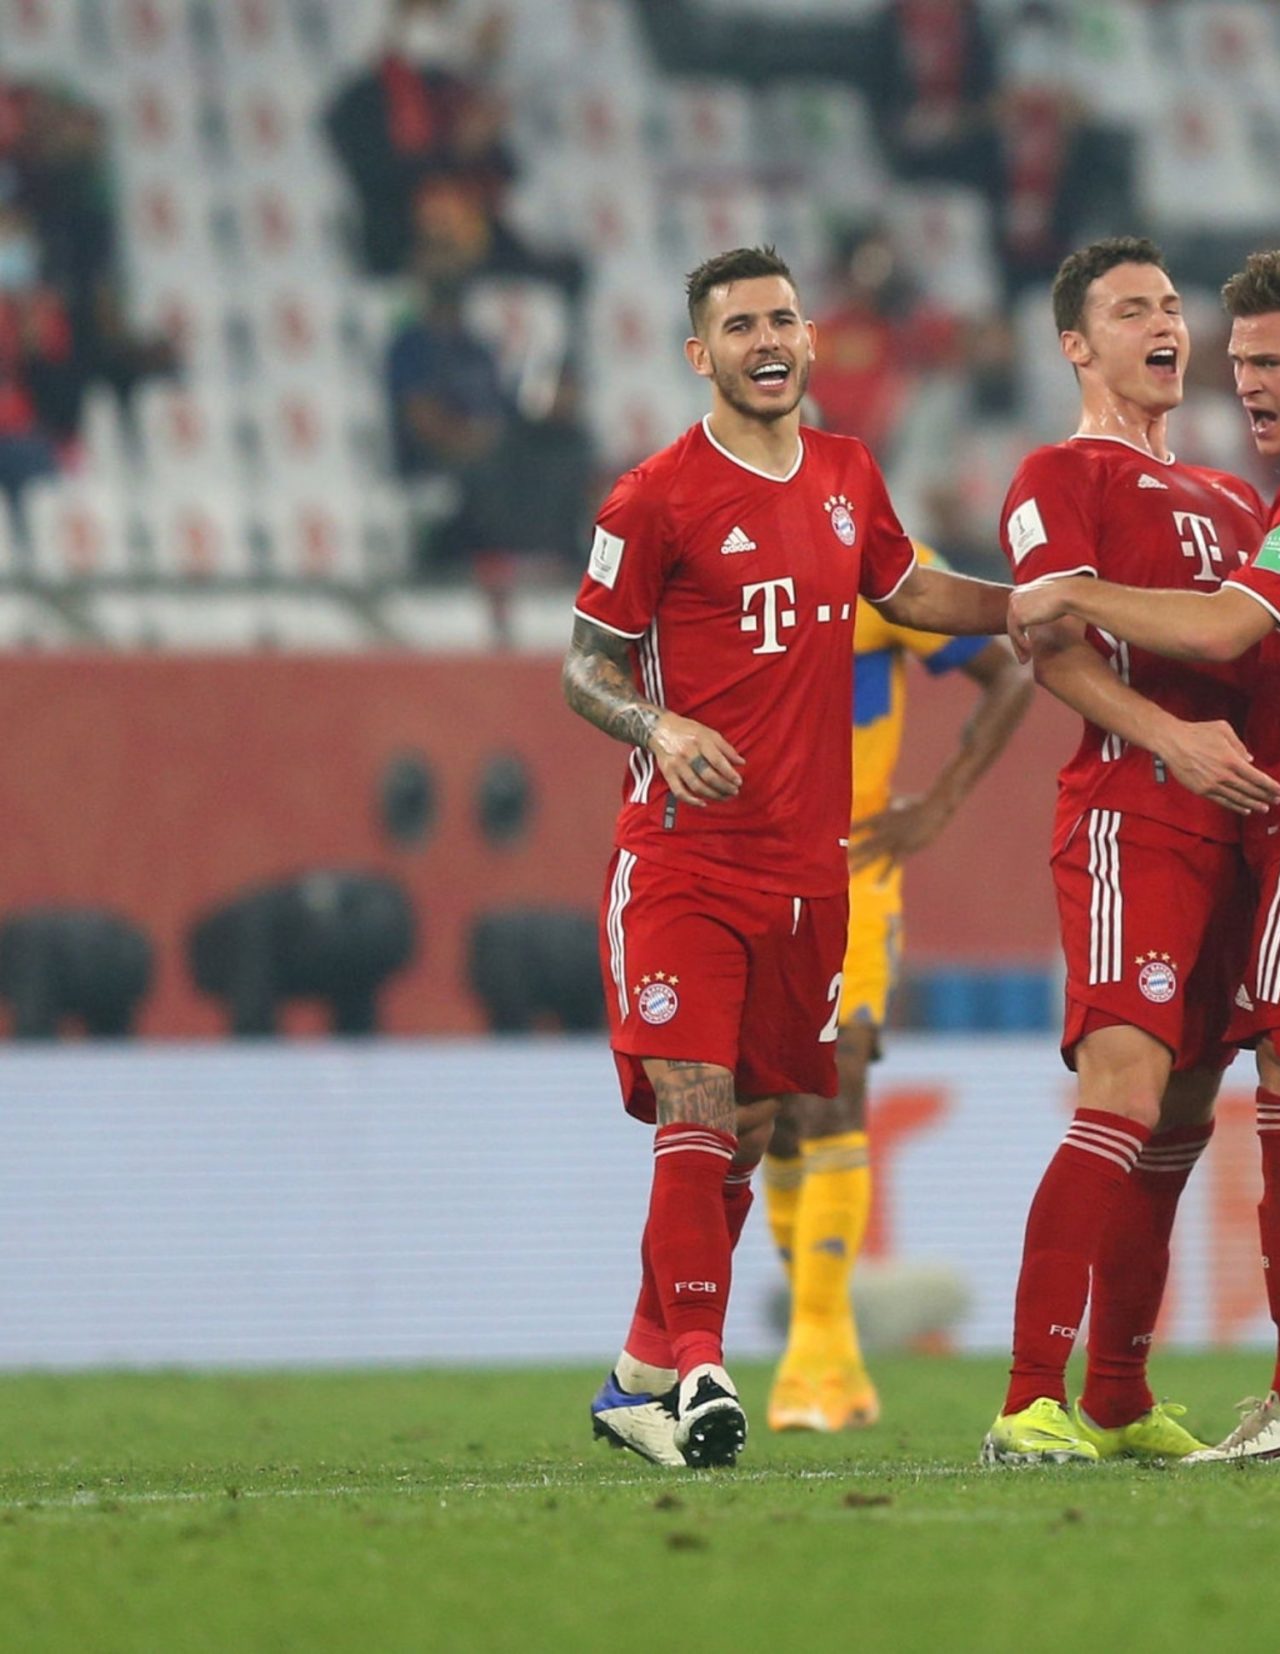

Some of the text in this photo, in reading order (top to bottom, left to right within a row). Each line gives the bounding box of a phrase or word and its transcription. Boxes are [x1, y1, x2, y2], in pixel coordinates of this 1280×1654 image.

[720, 541, 757, 555] adidas
[818, 972, 843, 1043] 2
[674, 1280, 717, 1294] FCB
[1132, 1333, 1153, 1347] FC
